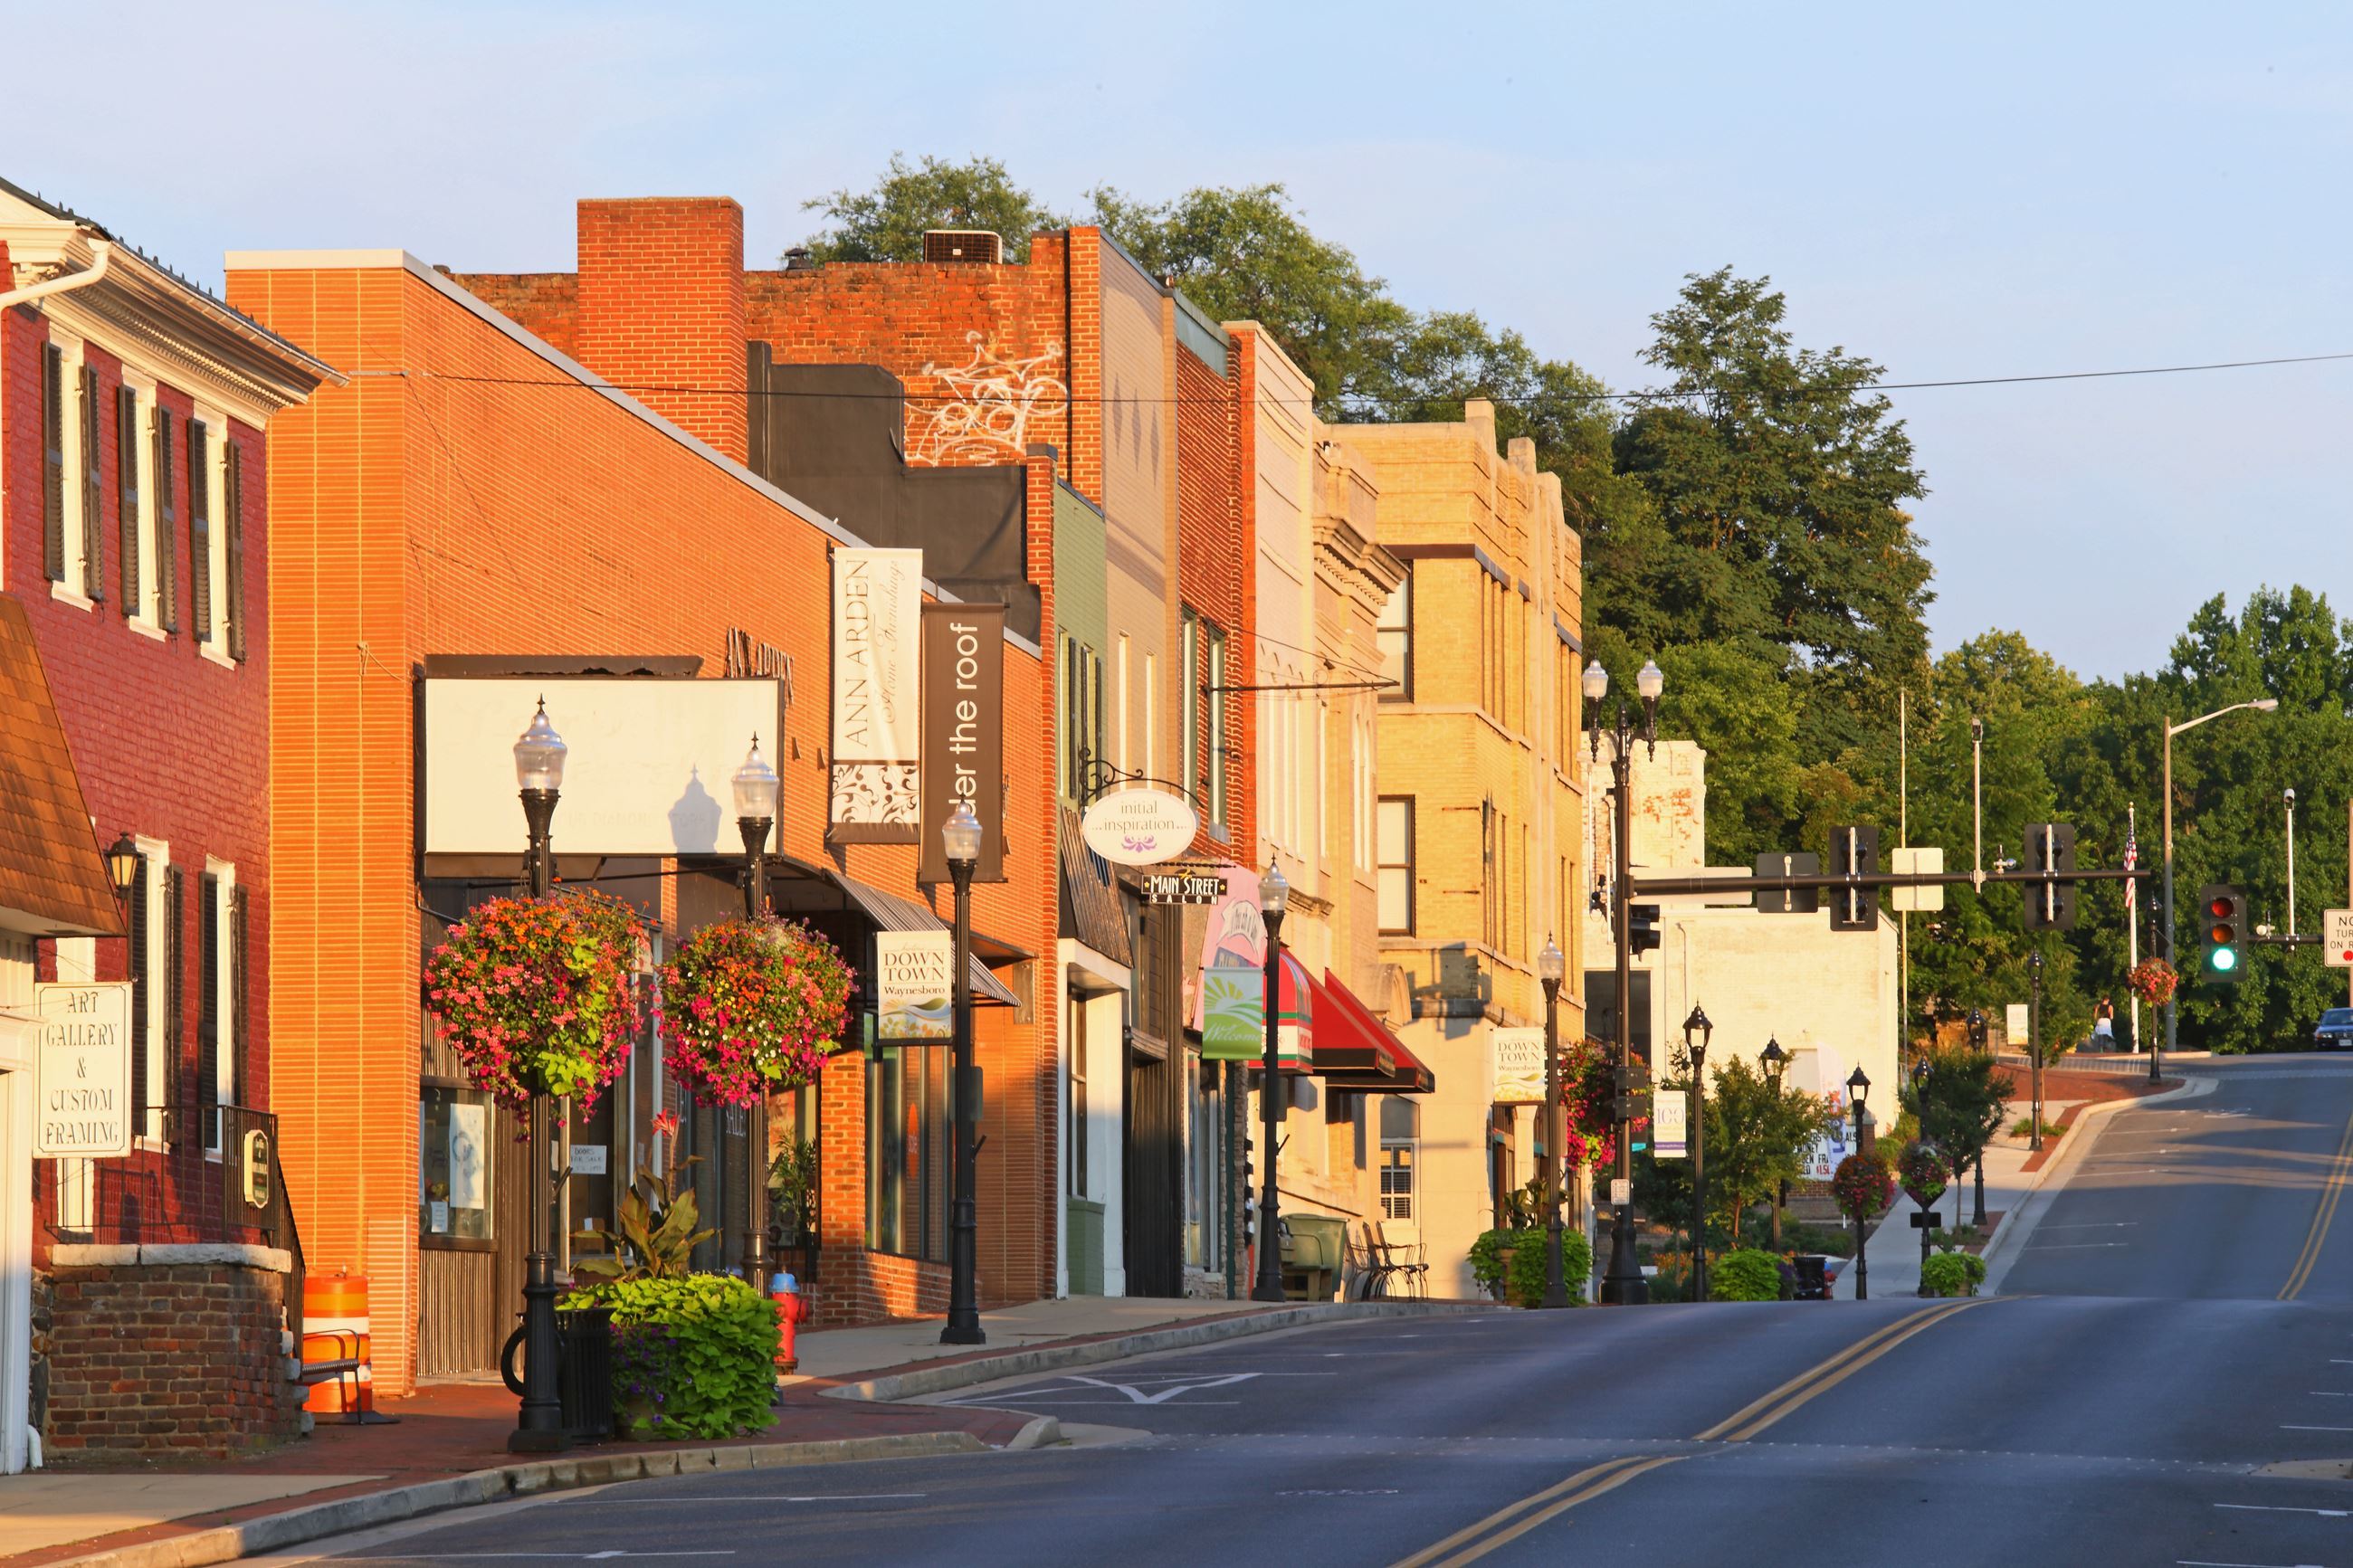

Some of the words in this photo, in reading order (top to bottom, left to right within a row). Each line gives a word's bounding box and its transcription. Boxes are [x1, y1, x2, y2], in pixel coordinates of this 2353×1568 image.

[846, 559, 869, 667] ARDEN
[950, 622, 978, 689] roof
[845, 679, 868, 747] ANN
[949, 699, 977, 755] the
[1121, 800, 1158, 814] initial
[1150, 875, 1179, 895] MAIN
[1183, 876, 1220, 896] STREET
[1151, 894, 1217, 905] SALON
[884, 951, 945, 966] DOWN
[883, 967, 945, 982] TOWN
[884, 985, 946, 997] Waynesboro
[67, 991, 99, 1013] ART
[46, 1023, 118, 1046] GALLERY
[1498, 1041, 1540, 1051] DOWN
[77, 1056, 86, 1079] &
[1498, 1052, 1540, 1062] TOWN
[51, 1088, 113, 1112] CUSTOM
[1656, 1107, 1684, 1125] 100
[45, 1121, 119, 1145] FRAMING
